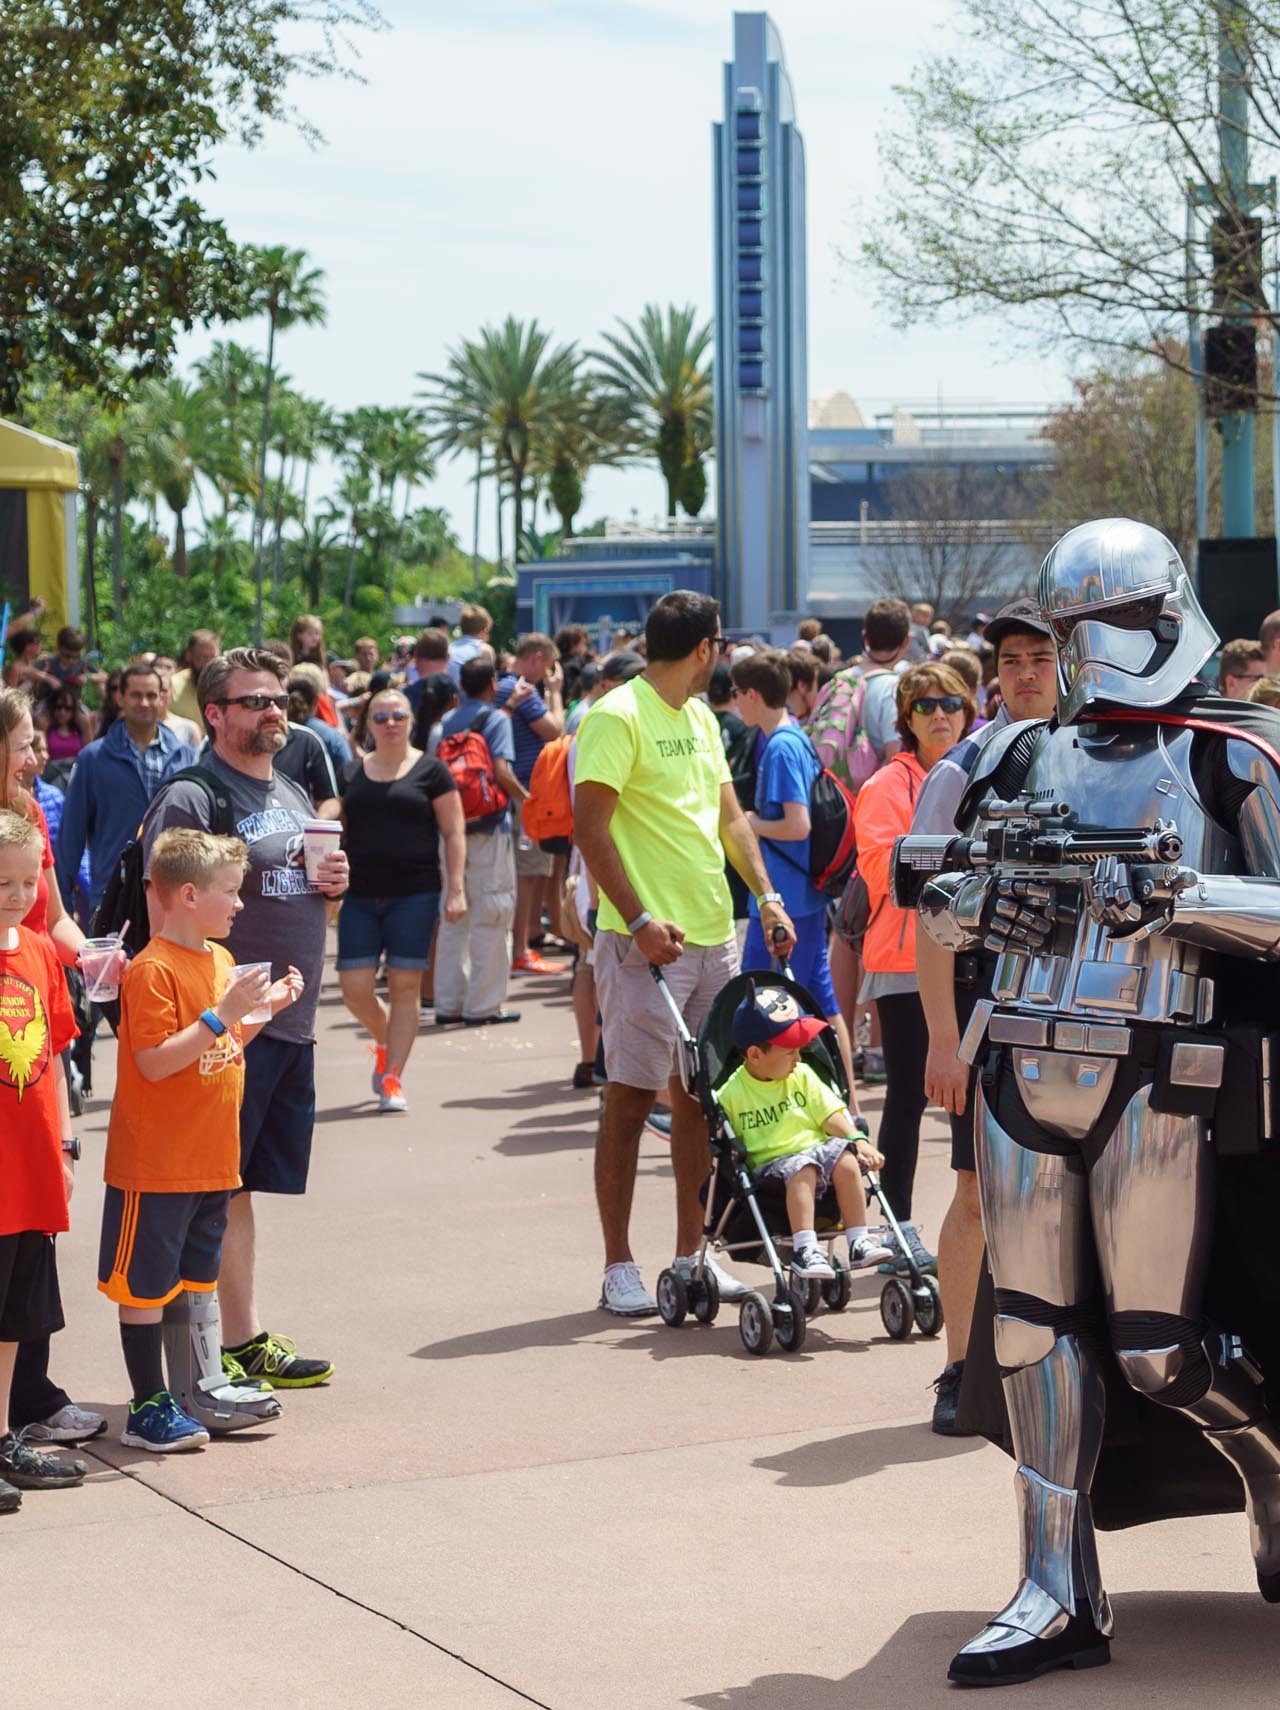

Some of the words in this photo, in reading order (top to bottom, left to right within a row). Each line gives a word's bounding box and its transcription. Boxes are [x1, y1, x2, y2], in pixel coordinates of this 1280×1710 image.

[655, 738, 685, 758] TEAM
[236, 808, 300, 845] TAMPA
[262, 869, 318, 897] LIGHT
[739, 1105, 780, 1131] TEAM
